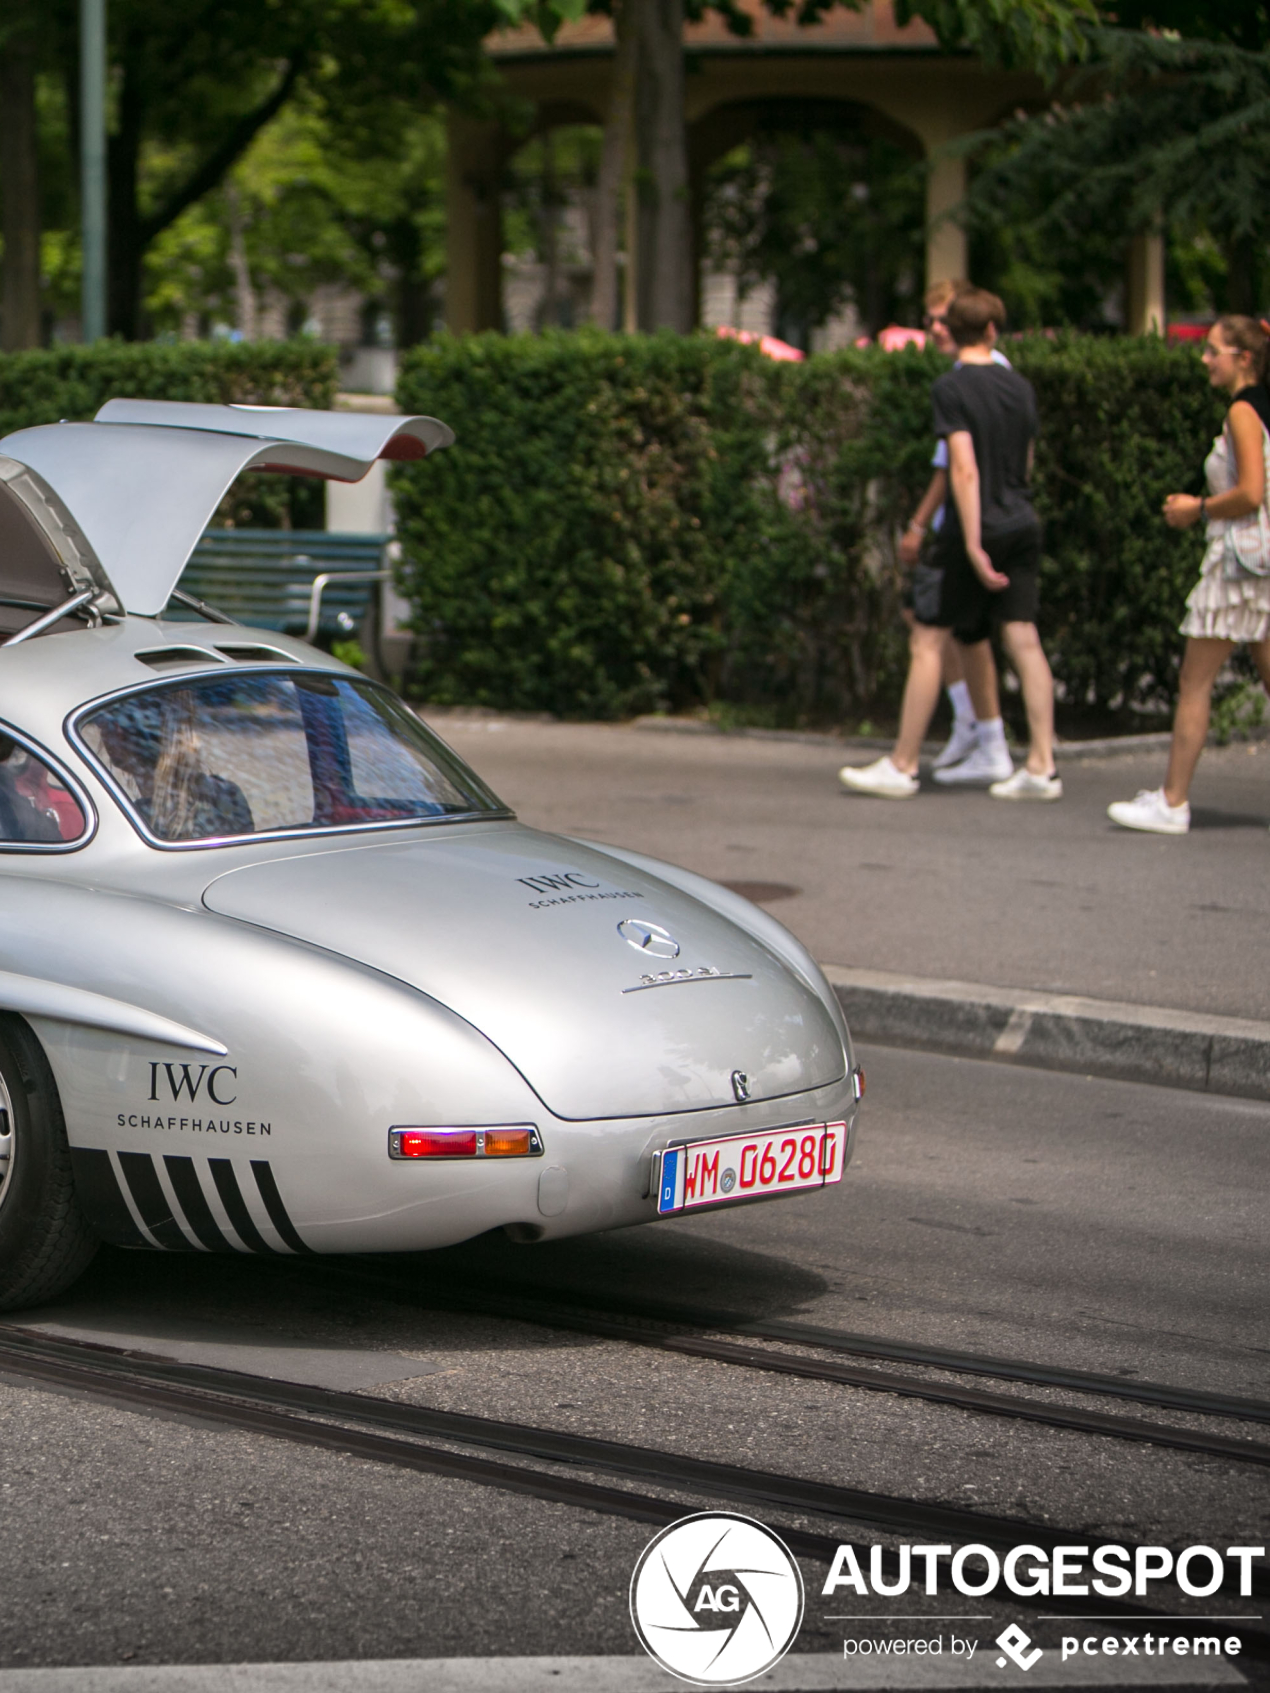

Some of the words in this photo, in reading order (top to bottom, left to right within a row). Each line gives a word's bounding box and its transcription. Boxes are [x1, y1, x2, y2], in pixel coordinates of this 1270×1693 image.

[515, 872, 600, 894] IWC
[528, 891, 645, 909] SCHAFFHAUSEN
[147, 1061, 238, 1106] IWC
[117, 1113, 272, 1136] SCHAFFHAUSEN
[664, 1186, 672, 1200] D
[684, 1149, 720, 1200] WM
[739, 1132, 838, 1190] 06280
